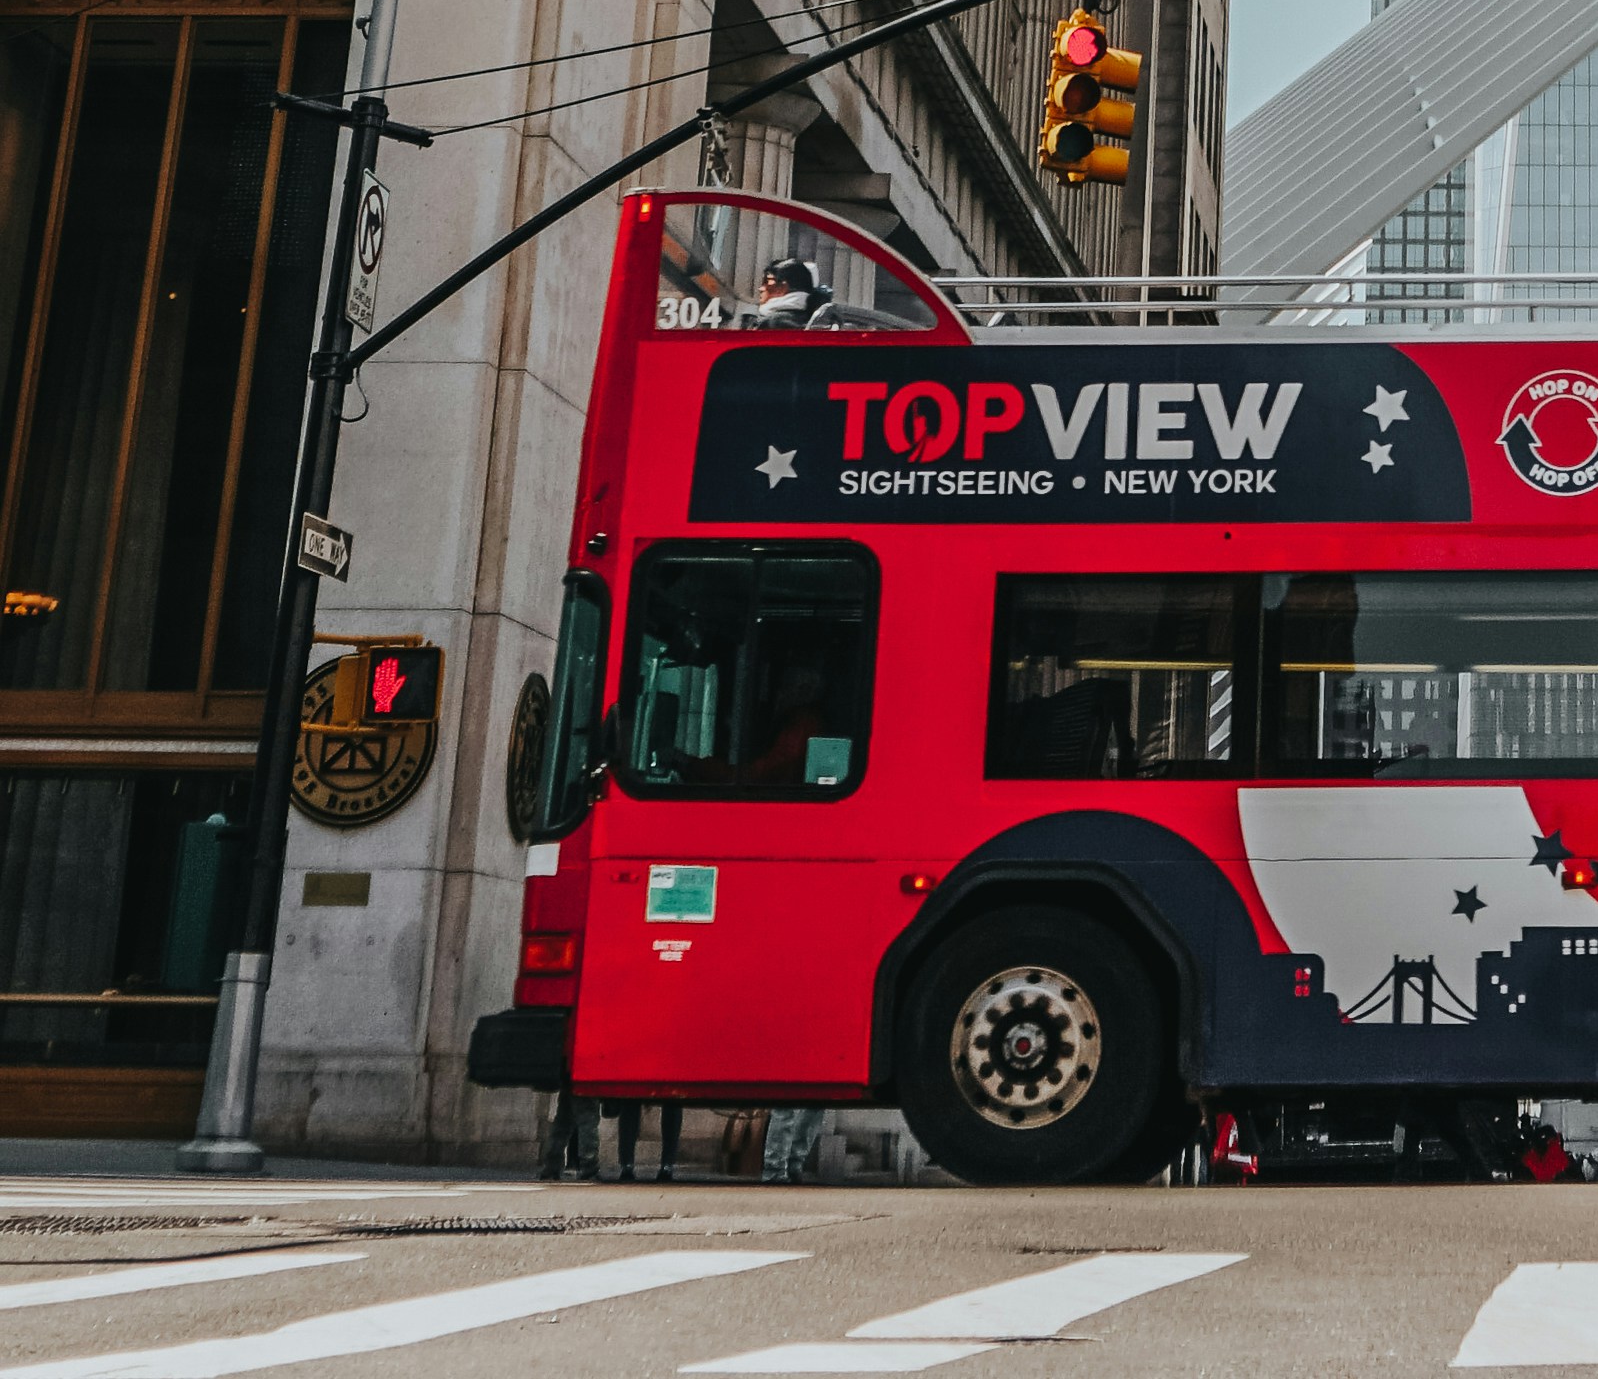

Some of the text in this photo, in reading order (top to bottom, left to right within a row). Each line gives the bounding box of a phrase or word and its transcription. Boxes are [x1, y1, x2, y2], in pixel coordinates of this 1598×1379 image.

[658, 297, 722, 330] 304
[1528, 379, 1569, 400] HOP
[838, 469, 1277, 495] SIGHTSEEING NEW YORK
[1529, 464, 1570, 487] HOP
[309, 533, 345, 564] ONE WAY
